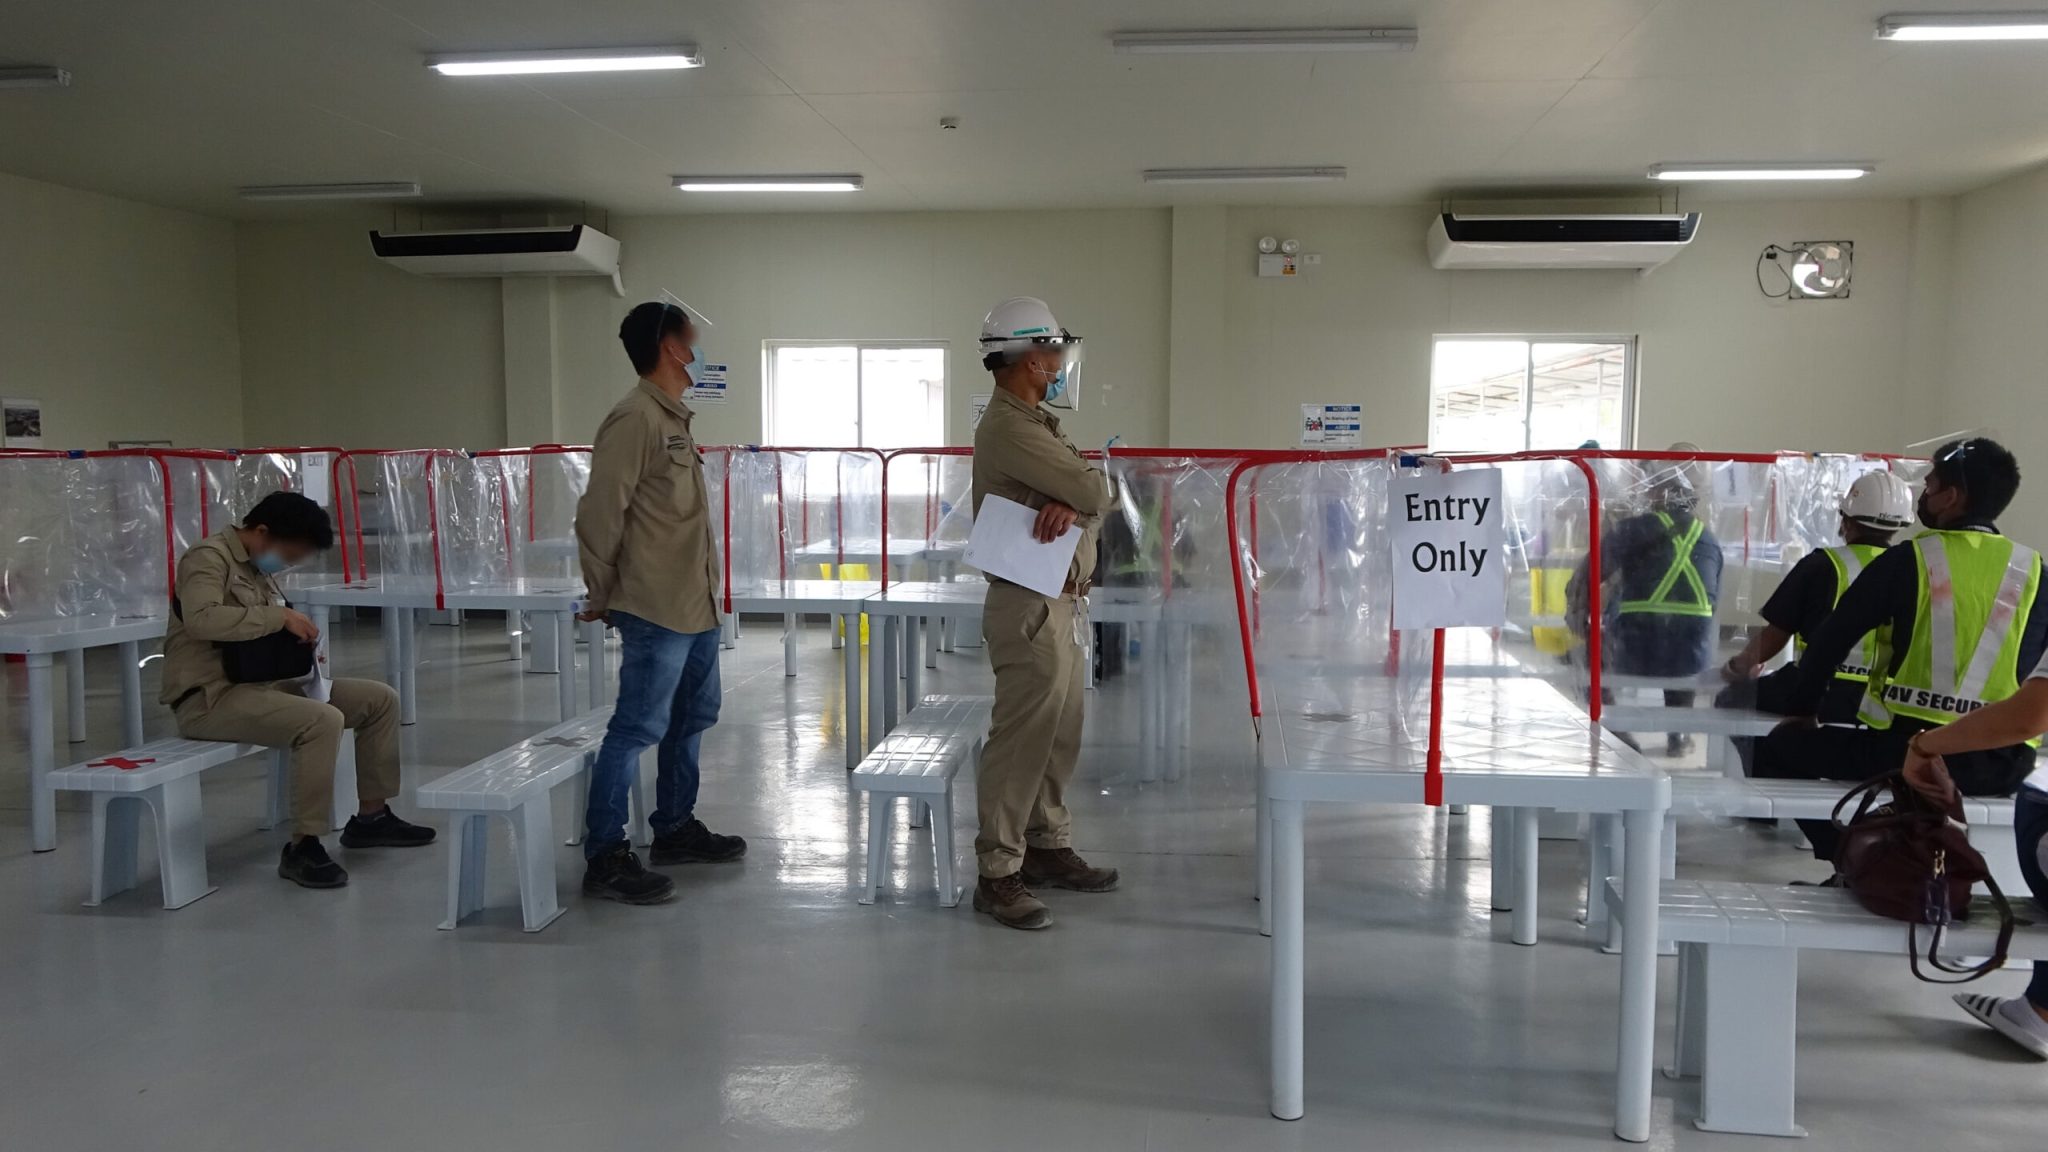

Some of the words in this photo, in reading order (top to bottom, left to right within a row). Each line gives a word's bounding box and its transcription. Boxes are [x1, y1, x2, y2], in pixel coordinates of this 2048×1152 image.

[308, 454, 324, 467] EXIT
[1405, 493, 1491, 526] Entry
[1412, 540, 1488, 578] Only
[1838, 663, 1872, 676] SEC
[1915, 690, 1990, 714] SECUR
